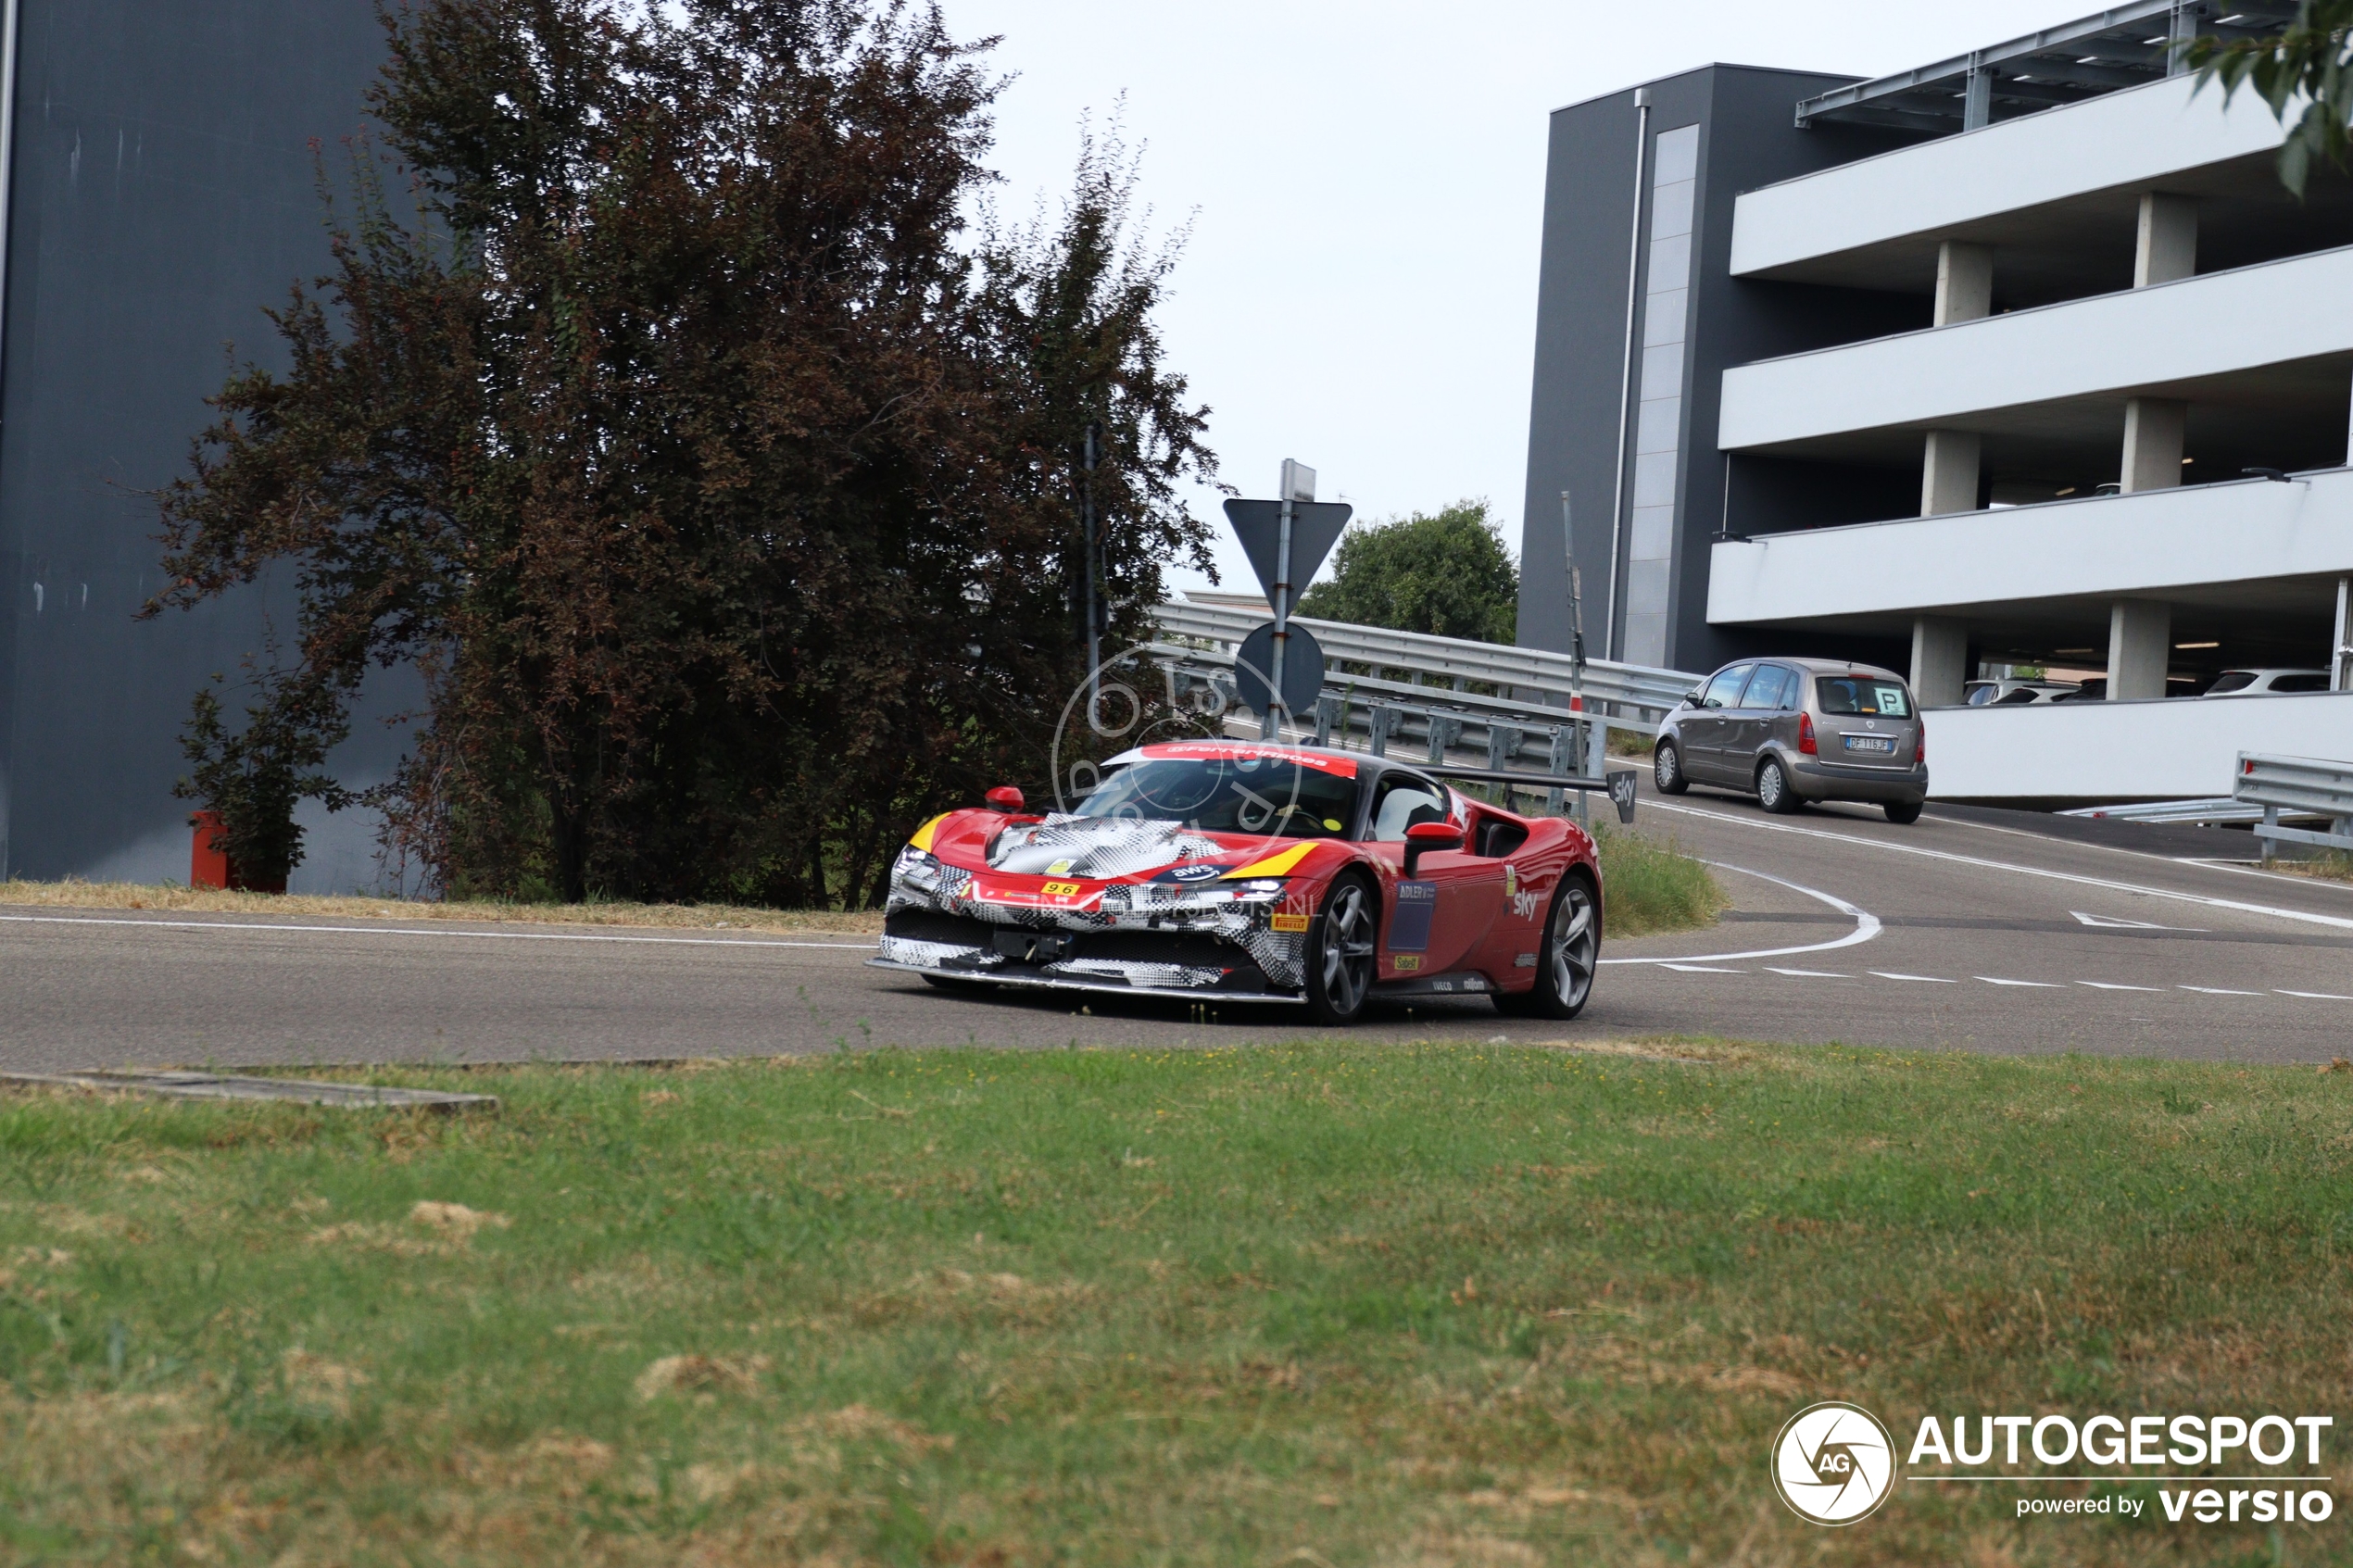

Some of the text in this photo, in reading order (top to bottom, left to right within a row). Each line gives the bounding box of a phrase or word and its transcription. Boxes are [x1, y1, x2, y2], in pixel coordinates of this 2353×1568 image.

[1881, 692, 1897, 710] P
[1851, 738, 1860, 747] DF
[1615, 773, 1635, 808] sky
[1171, 864, 1214, 877] aws
[1399, 885, 1423, 898] ADLER
[1513, 887, 1539, 922] sky
[1276, 916, 1306, 930] PIRELLI
[1396, 956, 1416, 969] Sabelt
[1432, 981, 1453, 992] IVECO
